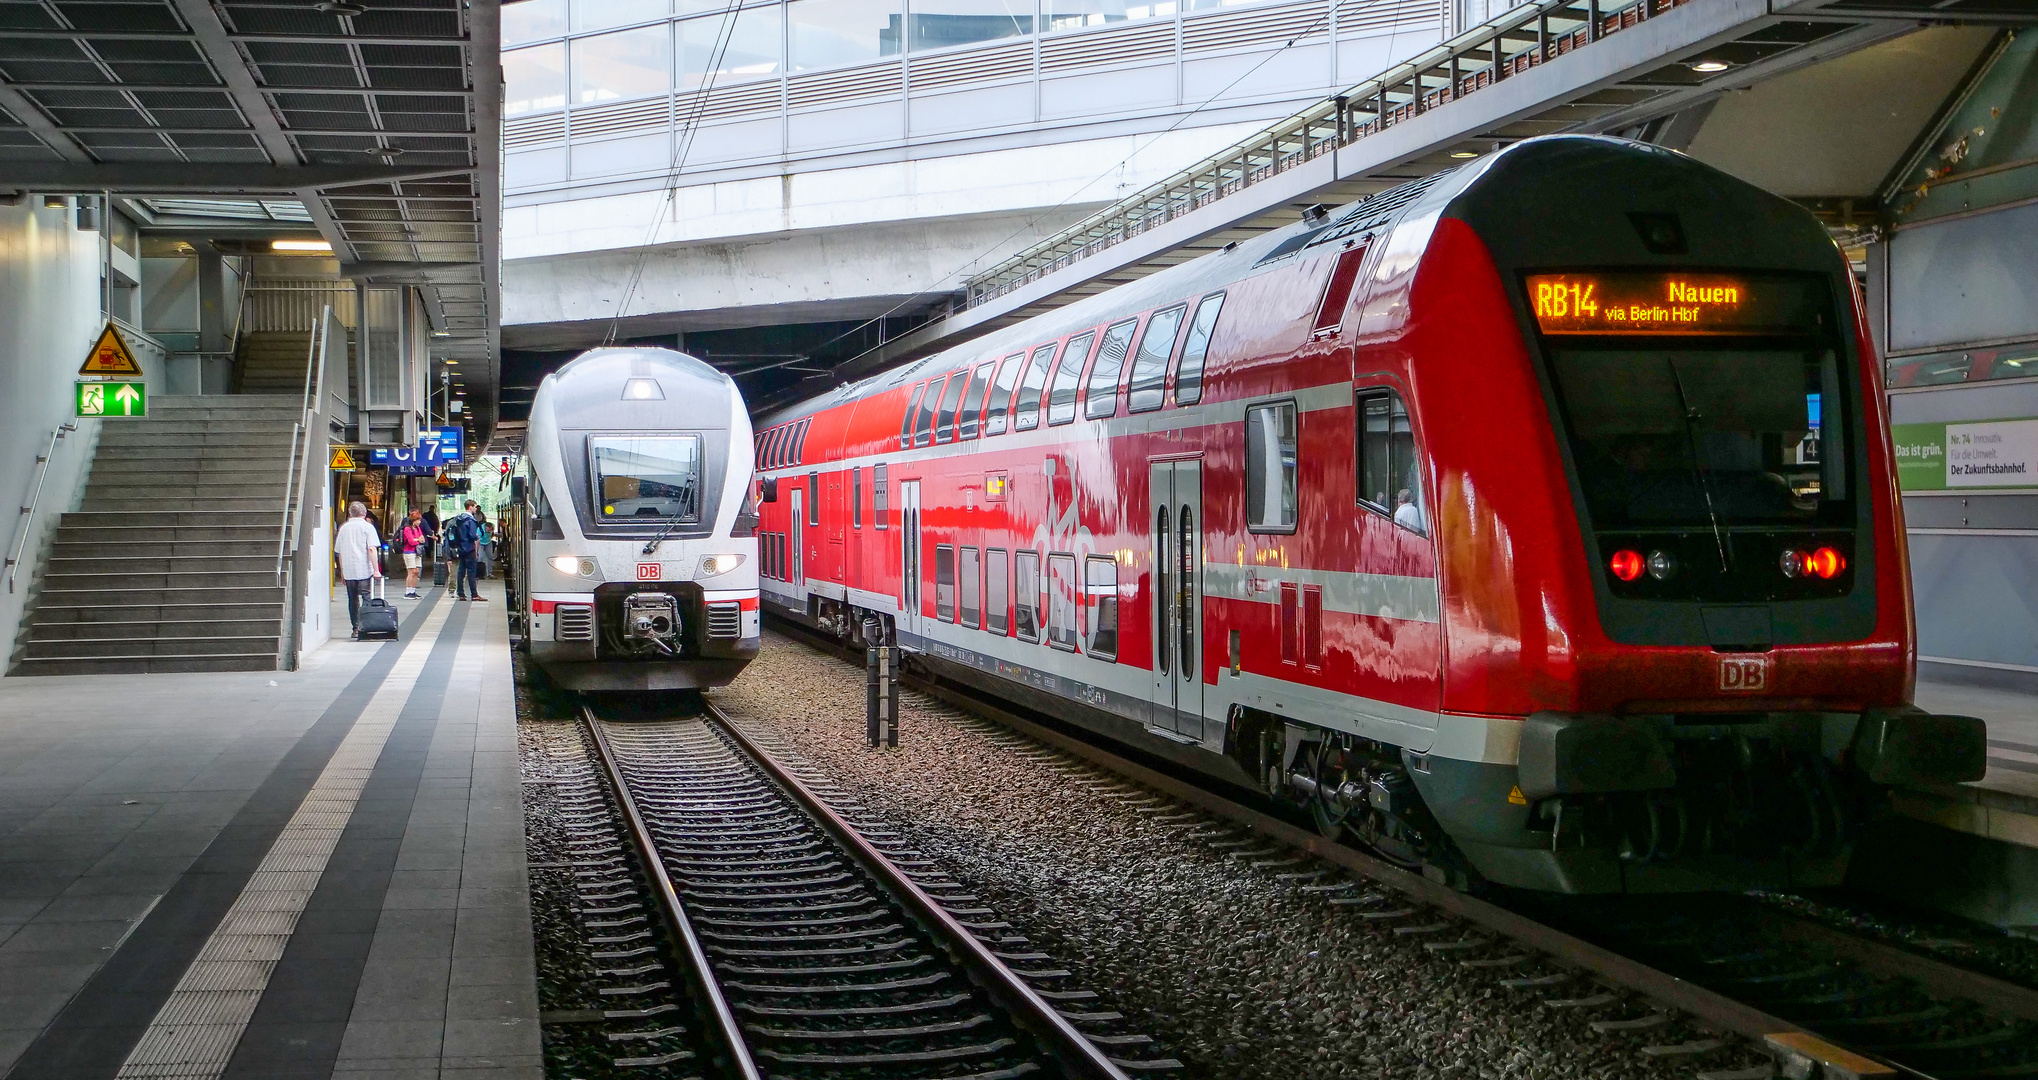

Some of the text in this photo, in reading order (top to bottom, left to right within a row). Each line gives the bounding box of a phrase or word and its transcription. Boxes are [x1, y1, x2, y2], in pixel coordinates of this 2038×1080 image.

[1538, 284, 1597, 317] RB14
[1669, 282, 1737, 303] Nauen
[1605, 306, 1699, 322] via Berlin Hbf
[1951, 435, 1960, 445] Nr.
[426, 440, 439, 461] 7
[1896, 442, 1942, 459] Das ist grün.
[1951, 450, 1961, 460] Für
[1962, 449, 1971, 460] die
[1951, 464, 1962, 475] Der
[1965, 462, 2026, 475] Zukunftsbahnhof.
[639, 565, 659, 578] DB
[1723, 661, 1762, 688] DB
